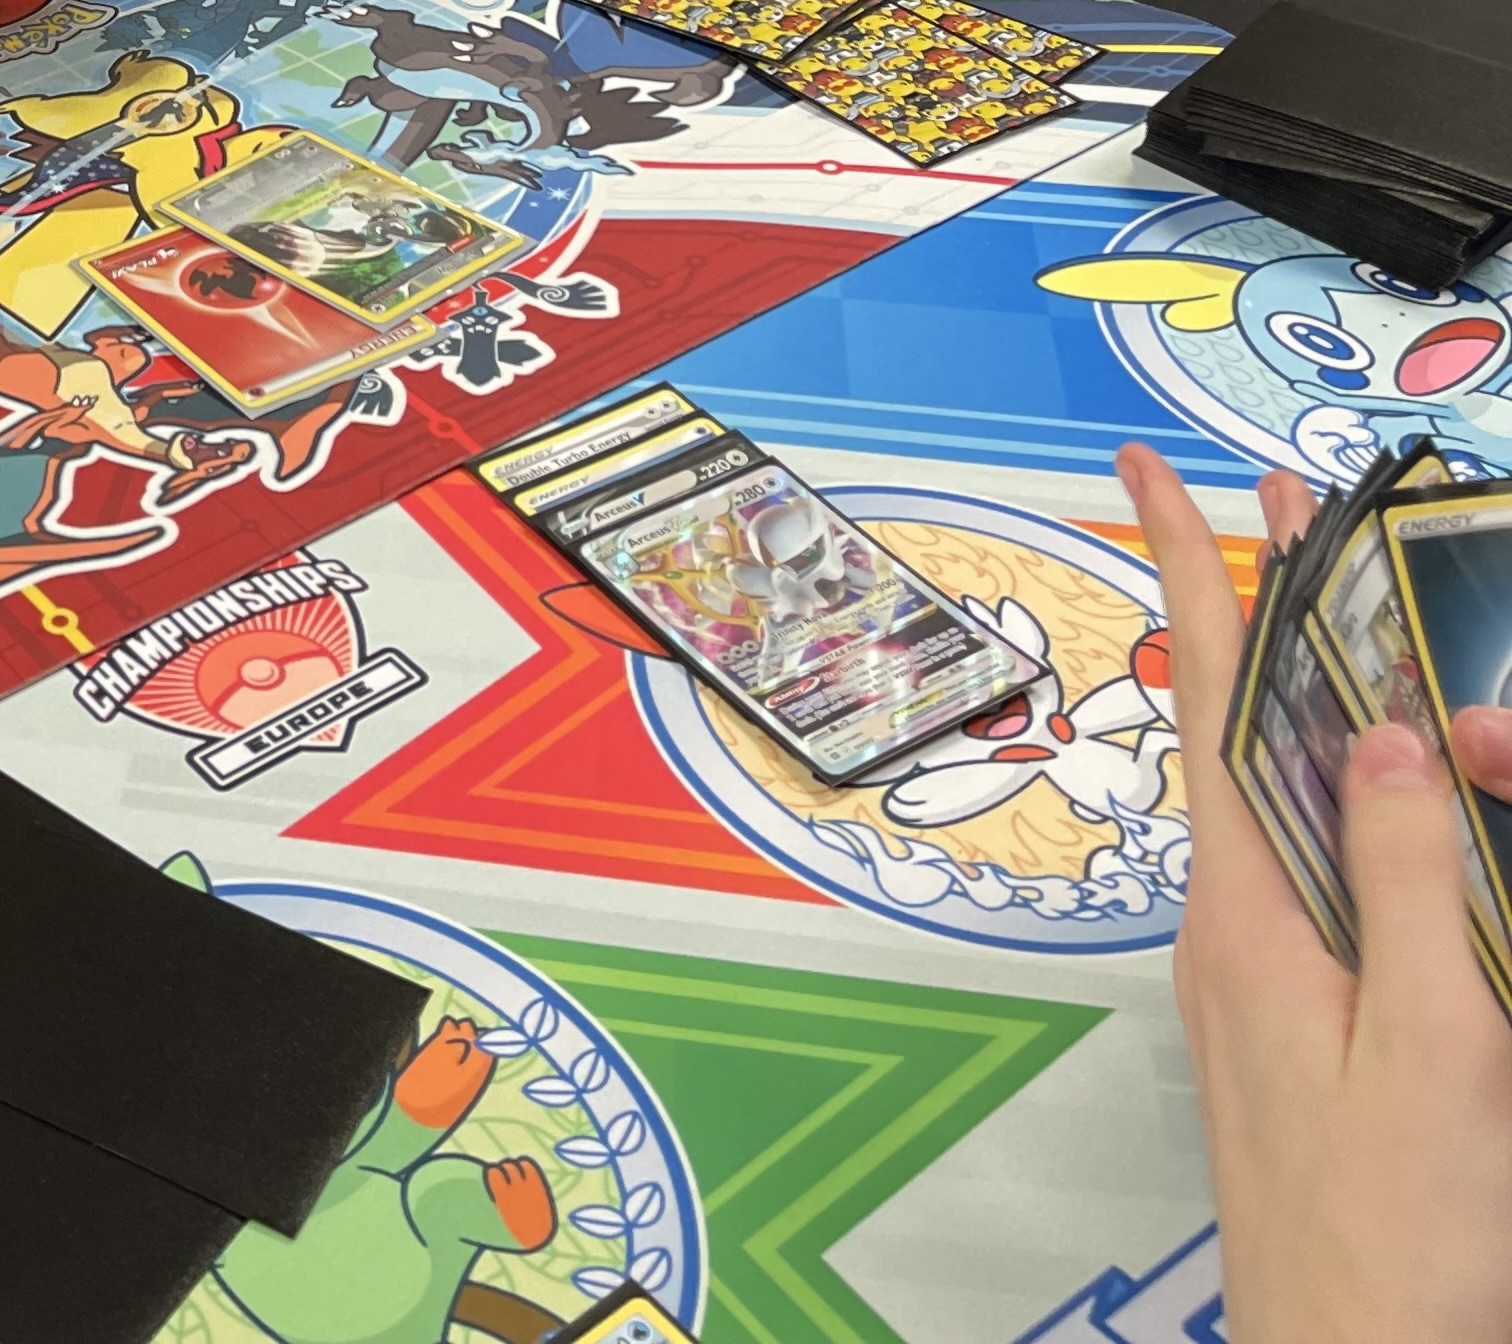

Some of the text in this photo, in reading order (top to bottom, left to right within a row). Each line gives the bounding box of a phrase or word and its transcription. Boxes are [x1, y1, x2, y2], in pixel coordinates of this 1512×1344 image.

[350, 320, 421, 359] ENERGY
[494, 445, 555, 478] ENERGY
[506, 430, 631, 487] Double Turbo Energy
[528, 475, 590, 505] ENERGY
[594, 500, 636, 522] Arceus
[705, 459, 730, 478] 220
[627, 525, 672, 550] Arceus
[741, 484, 766, 504] 280
[1399, 513, 1476, 534] ENERGY
[877, 578, 896, 592] 200
[78, 561, 362, 720] CHAMPIONSHIPS
[245, 681, 374, 754] EUROPE
